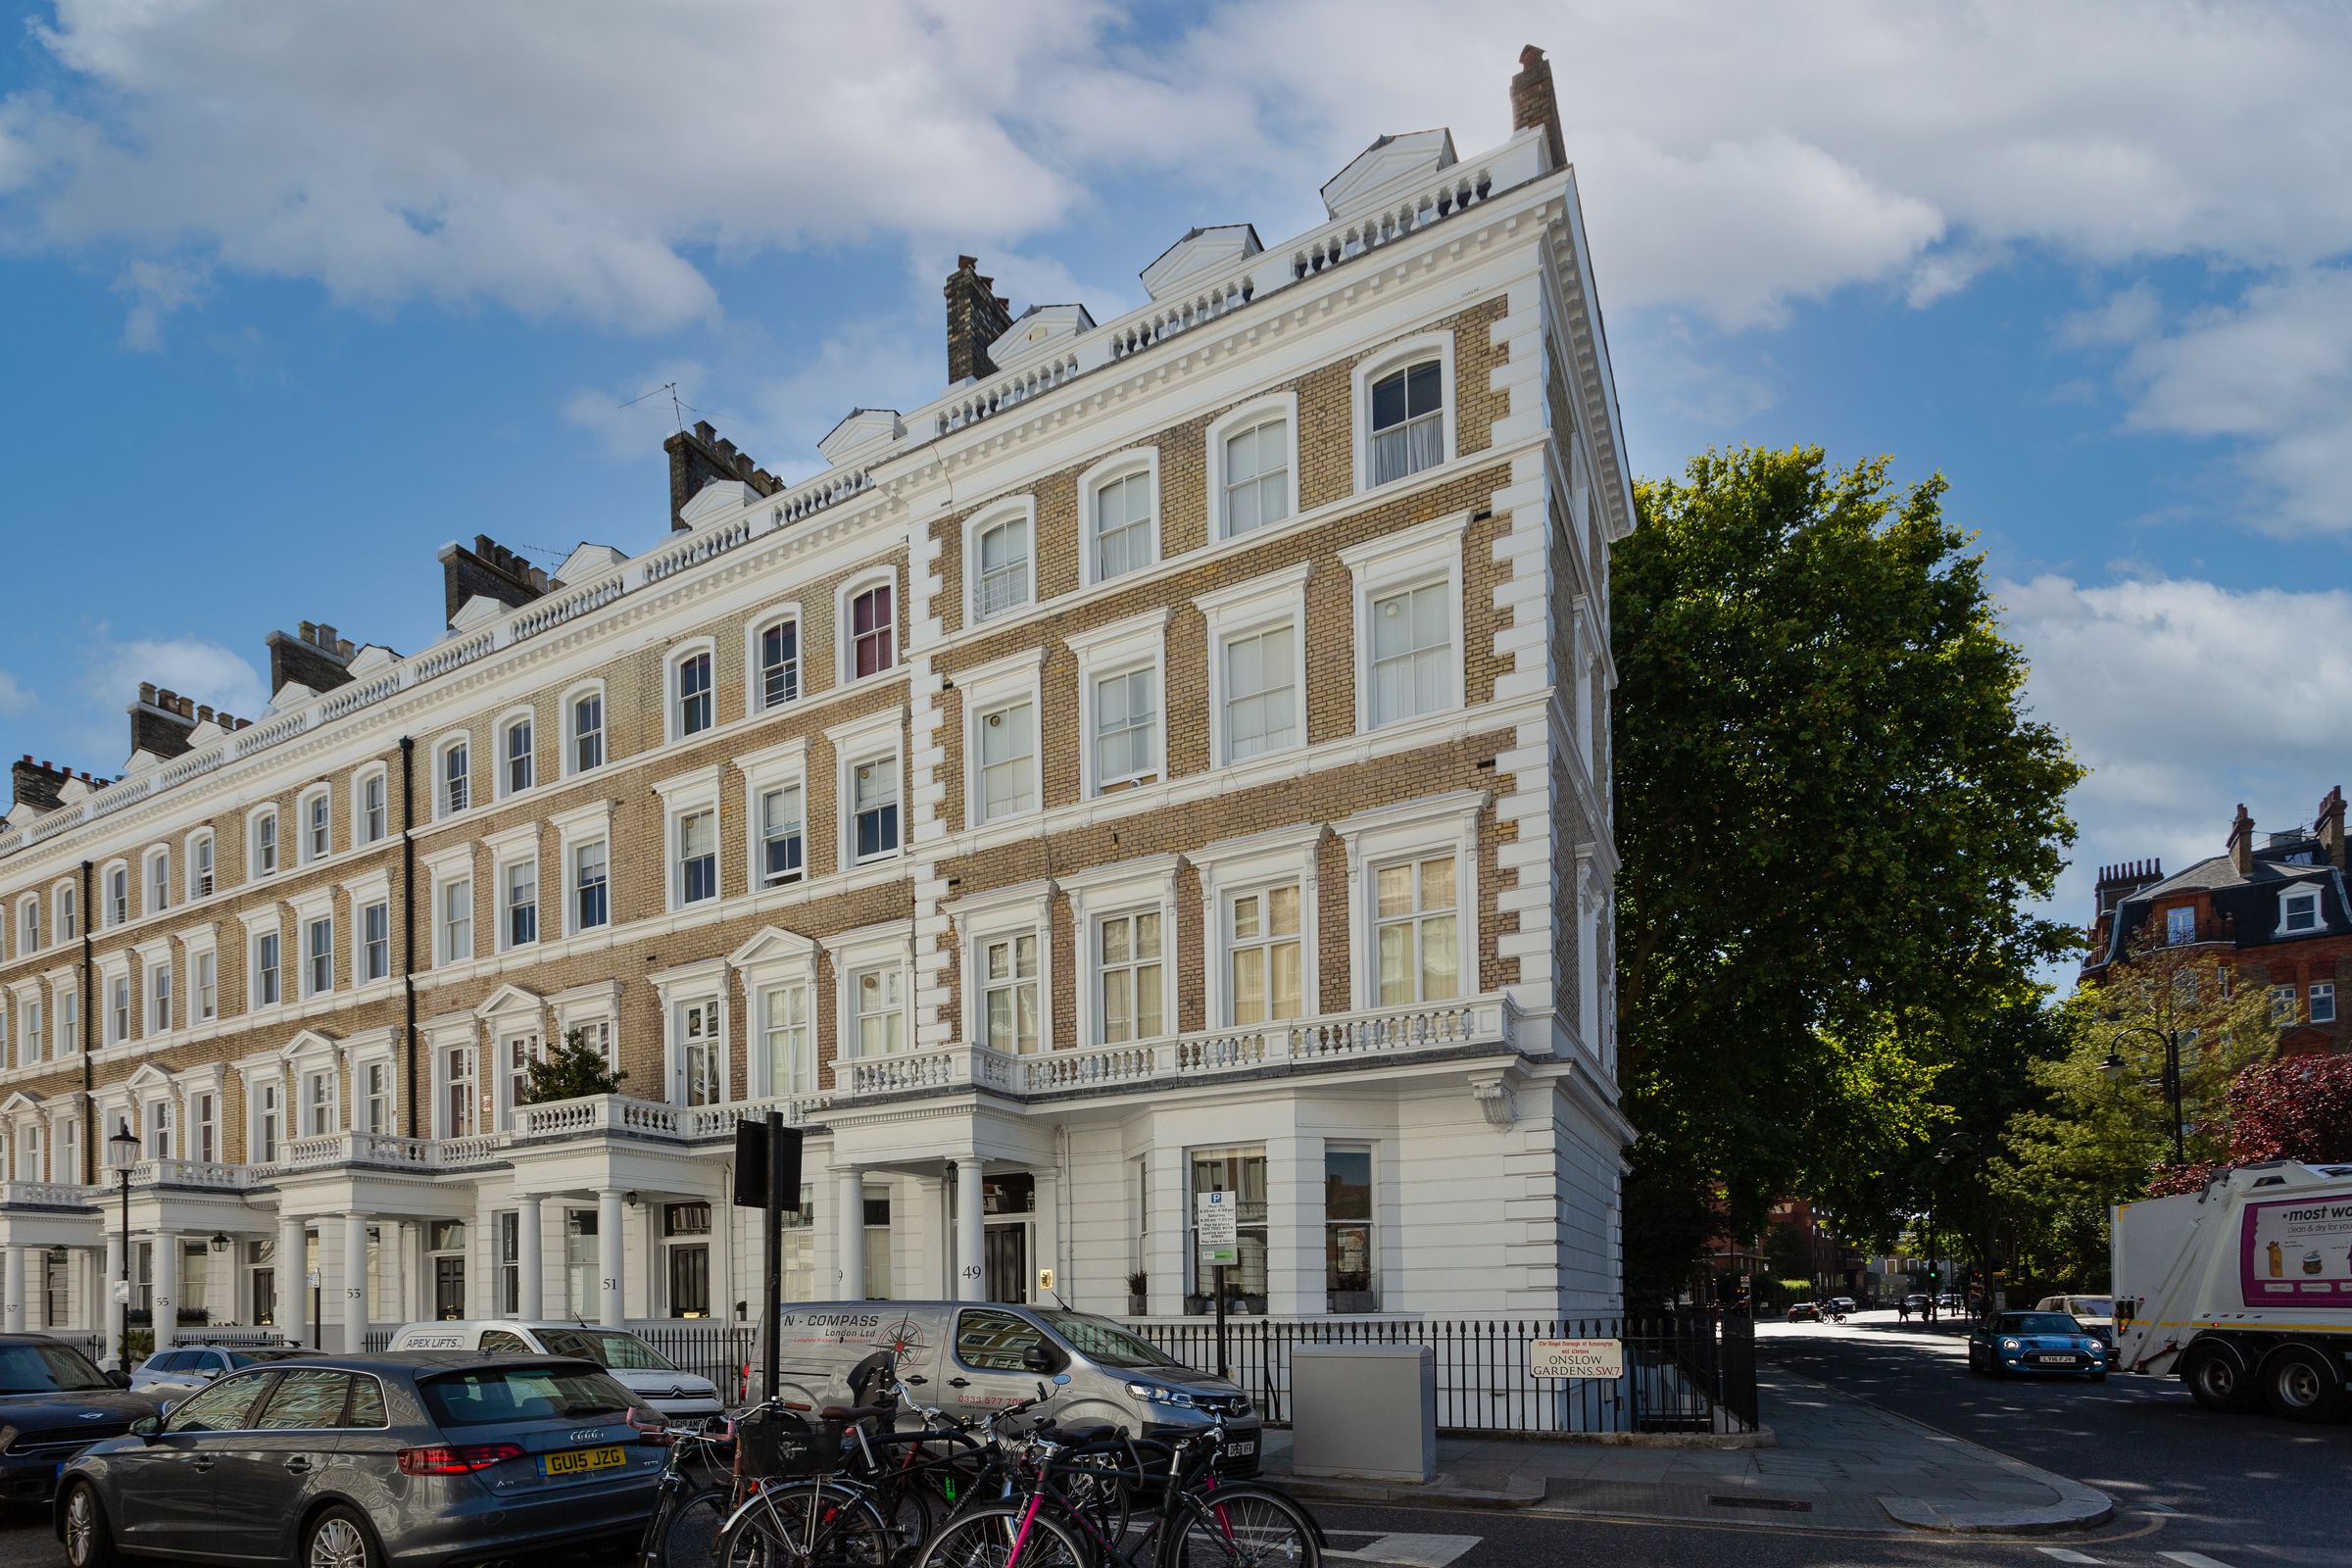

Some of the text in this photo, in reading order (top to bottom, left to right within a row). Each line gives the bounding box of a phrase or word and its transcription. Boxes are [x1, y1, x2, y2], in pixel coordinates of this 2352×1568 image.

[2289, 1205, 2328, 1221] most
[2315, 1223, 2327, 1233] dry
[962, 1266, 982, 1280] 49
[603, 1278, 616, 1290] 51
[347, 1289, 361, 1298] 53
[157, 1298, 170, 1306] 55
[784, 1315, 795, 1326] N
[808, 1315, 879, 1327] COMPASS
[407, 1339, 430, 1348] APEX
[432, 1339, 458, 1348] LIFTS
[1549, 1355, 1602, 1364] ONSLOW
[671, 1419, 687, 1428] LG19
[552, 1449, 620, 1472] GU15 JZG
